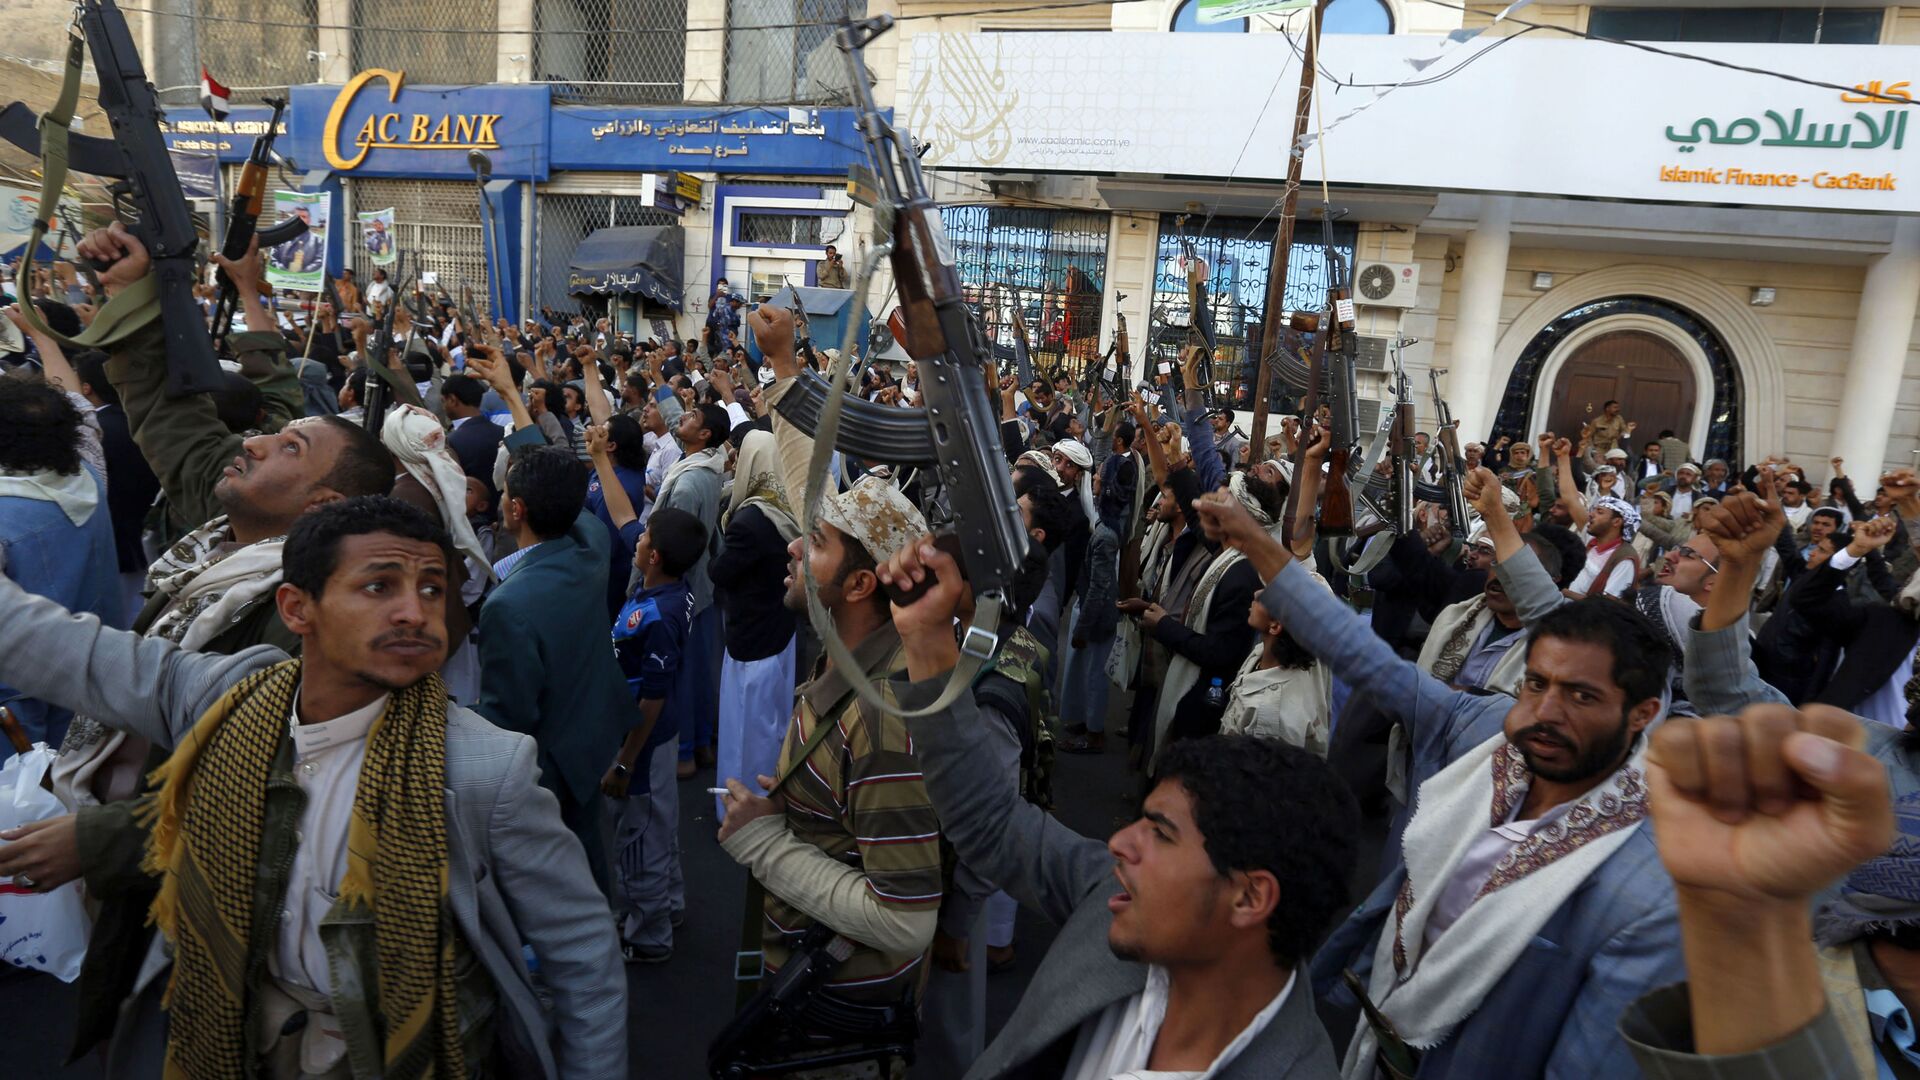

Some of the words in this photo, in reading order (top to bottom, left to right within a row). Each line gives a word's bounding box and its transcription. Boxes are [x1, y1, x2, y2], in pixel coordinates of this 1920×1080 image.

[322, 68, 406, 170] CAC
[408, 113, 502, 143] BANK
[654, 119, 718, 140] التعاوني
[720, 119, 789, 139] التسليف
[591, 119, 652, 141] والزراعي
[1665, 108, 1909, 153] الاسلامي
[714, 142, 748, 158] فرع
[1017, 136, 1130, 148] www.cacislamic.com.ye
[1659, 165, 1723, 184] Islamic
[1725, 168, 1798, 188] Finance
[1812, 171, 1898, 192] CacBank
